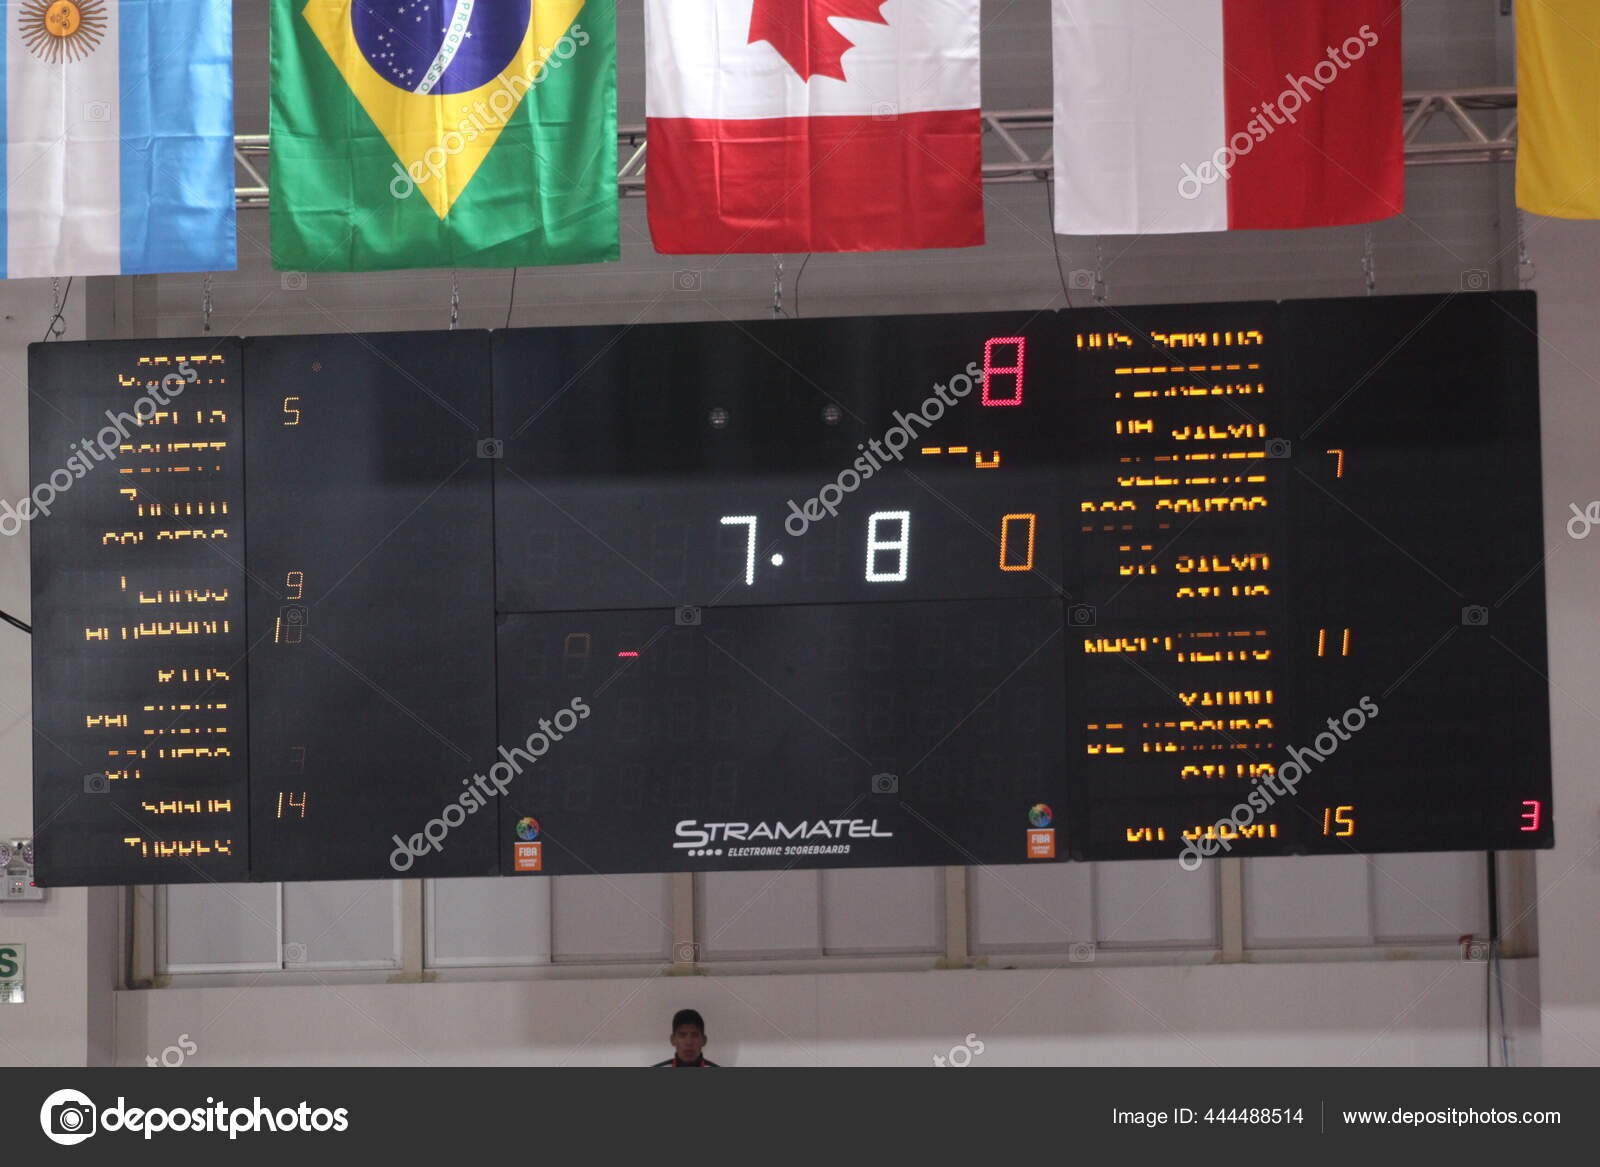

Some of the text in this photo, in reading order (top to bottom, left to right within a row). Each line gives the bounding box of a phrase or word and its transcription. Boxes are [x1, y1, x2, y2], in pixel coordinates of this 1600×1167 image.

[982, 336, 1026, 406] 8
[284, 397, 301, 425] 5
[1326, 450, 1344, 478] 7
[999, 512, 1037, 572] 0
[286, 571, 304, 600] 9
[276, 791, 307, 819] 14
[1520, 800, 1541, 832] 3
[672, 819, 893, 849] STRAMATEL
[1322, 805, 1355, 837] 15
[727, 844, 851, 857] ELECTRONIC SCOREBOARDS
